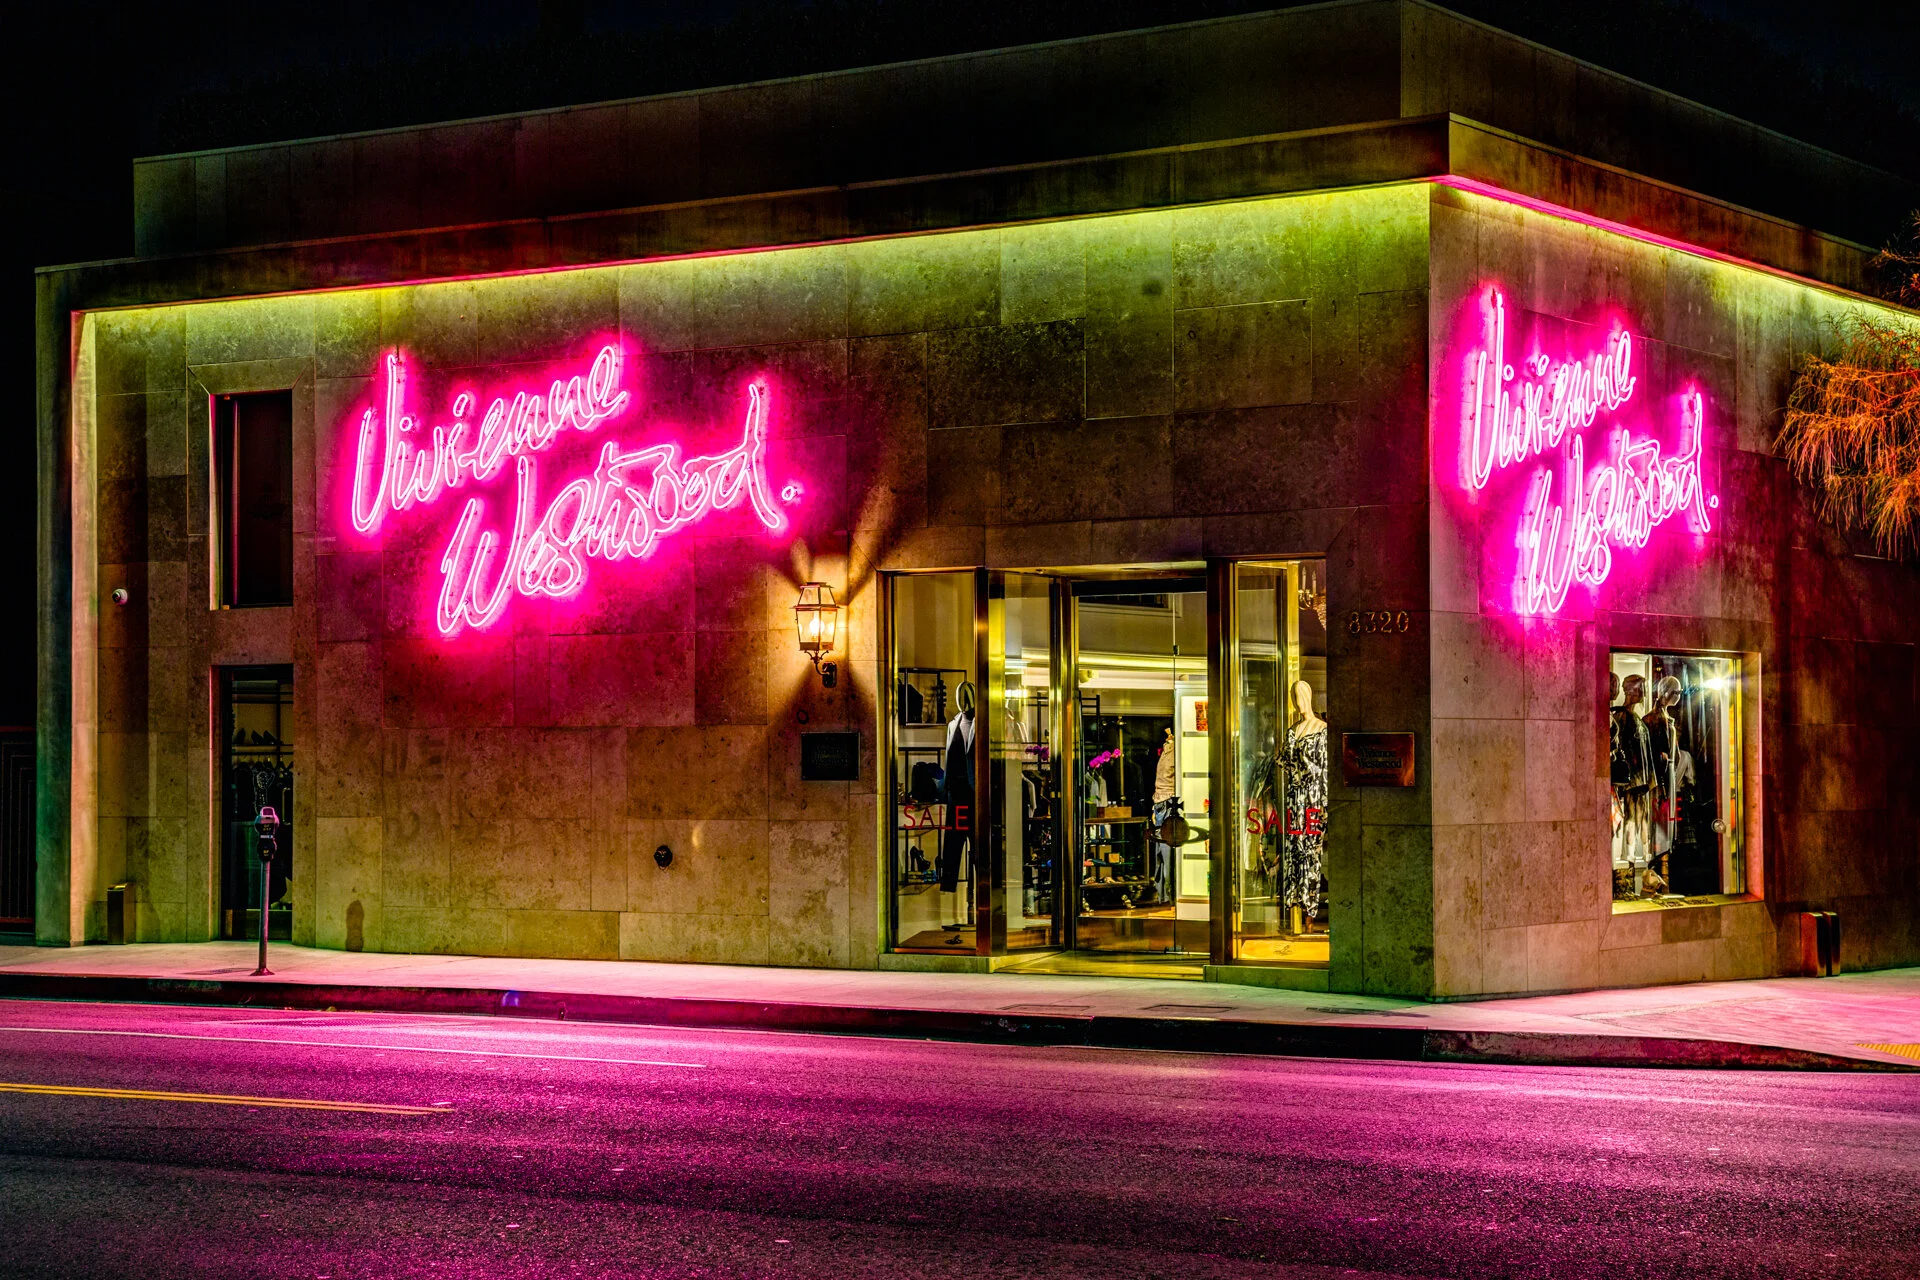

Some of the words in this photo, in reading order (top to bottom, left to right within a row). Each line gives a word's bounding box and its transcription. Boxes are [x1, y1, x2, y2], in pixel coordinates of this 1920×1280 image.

[1472, 292, 1636, 489] Vivienne
[351, 344, 628, 533] Vivienne
[1349, 611, 1409, 634] 8320
[903, 805, 969, 831] SALE
[1246, 808, 1322, 835] SALE
